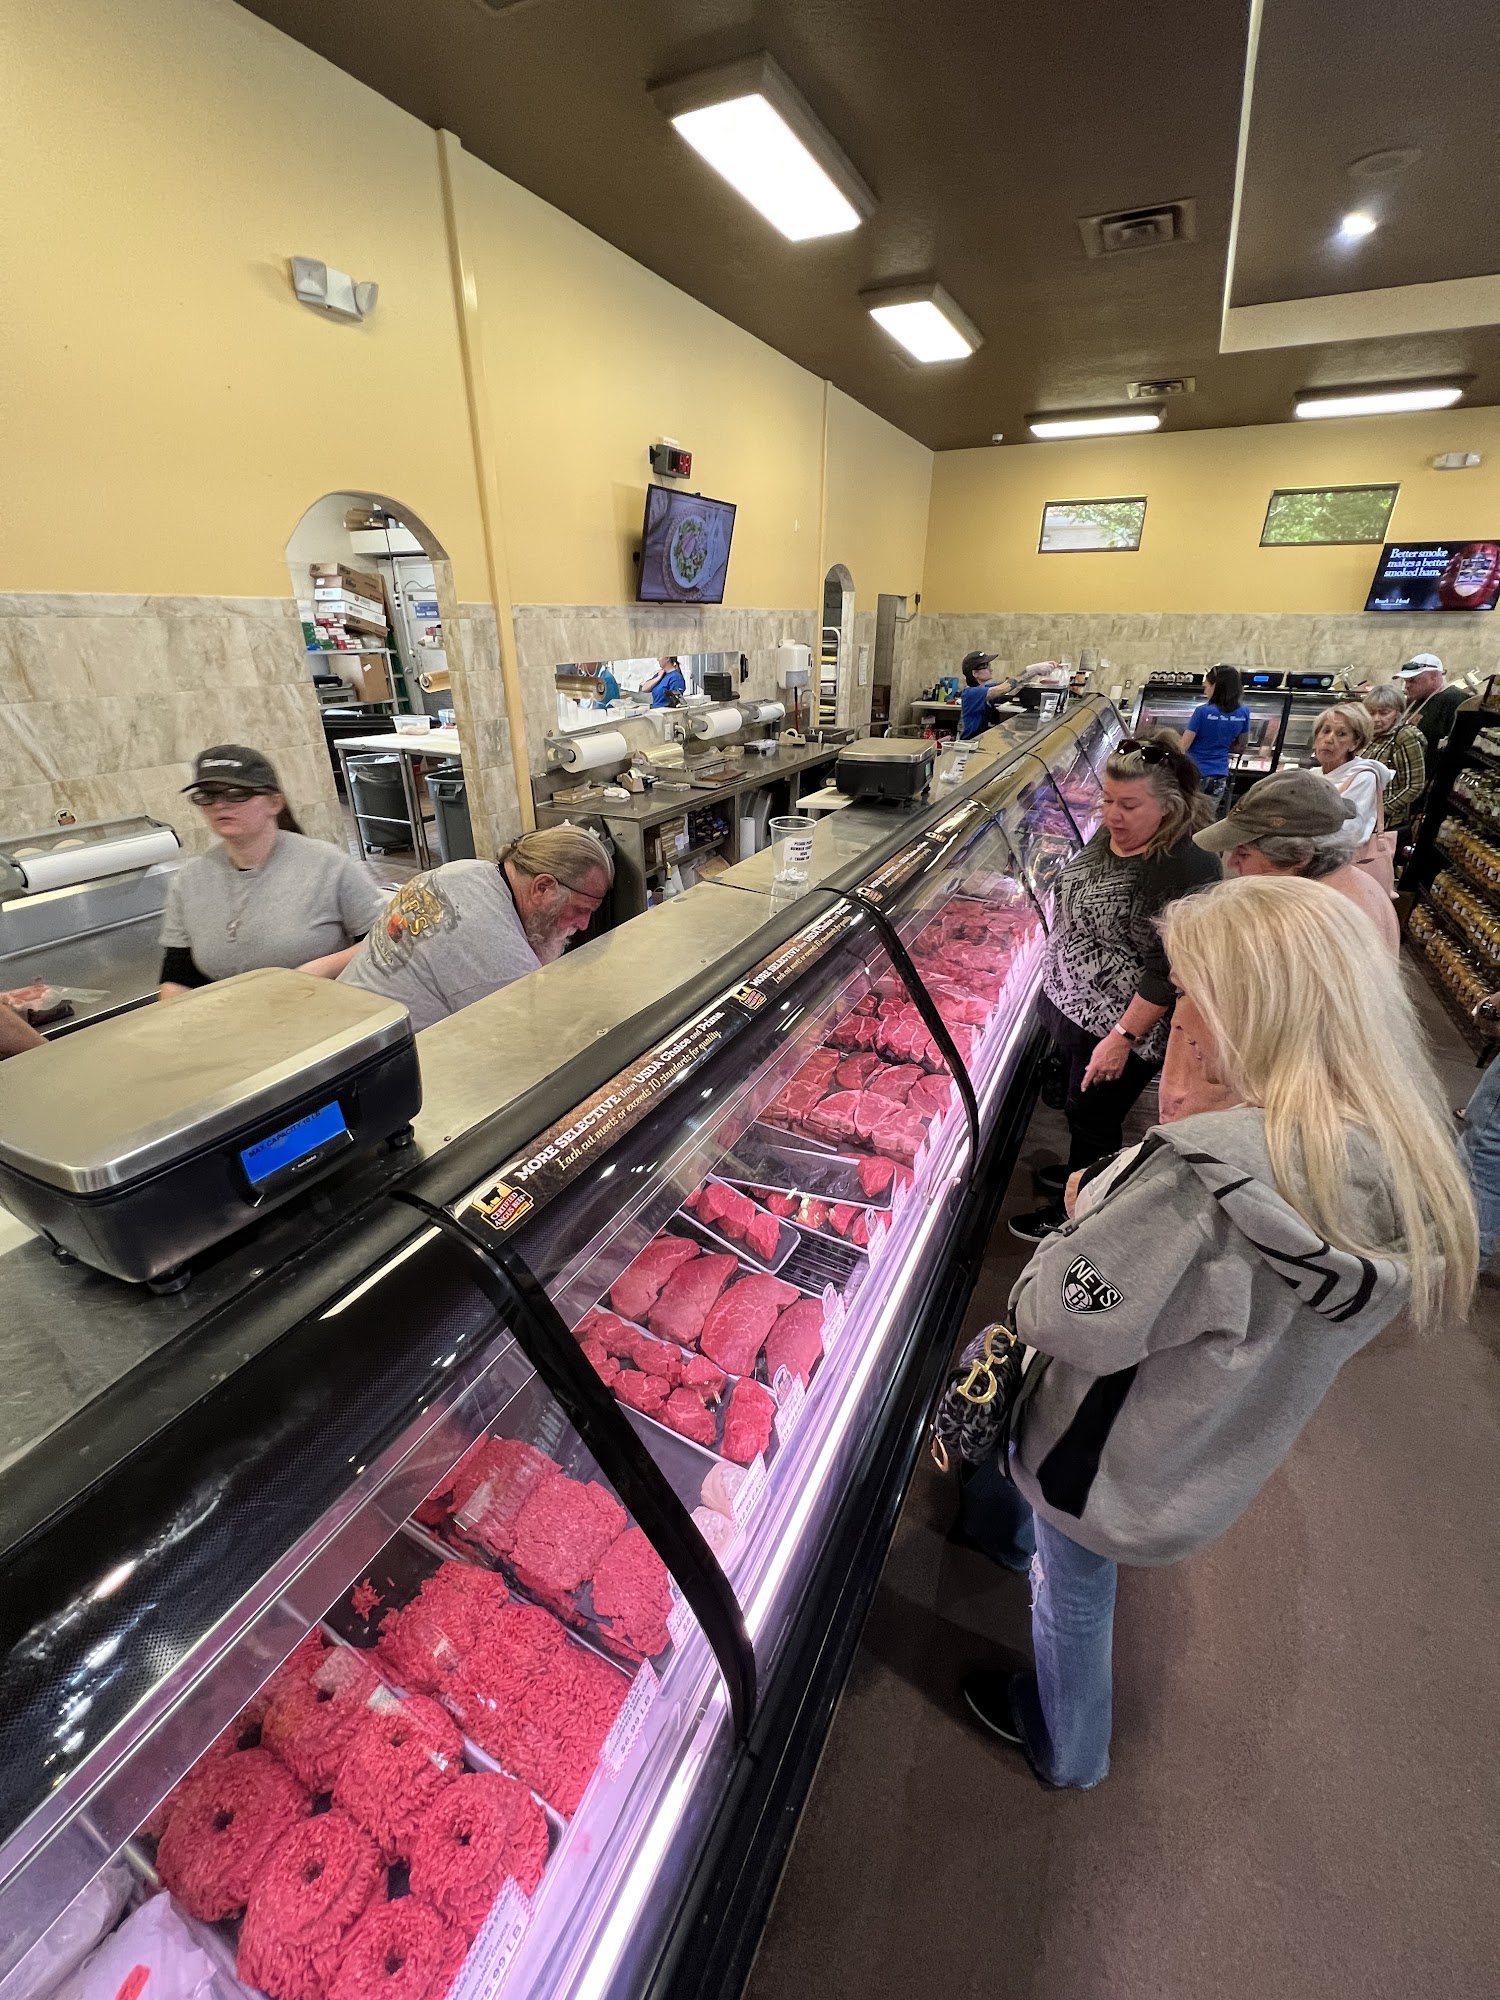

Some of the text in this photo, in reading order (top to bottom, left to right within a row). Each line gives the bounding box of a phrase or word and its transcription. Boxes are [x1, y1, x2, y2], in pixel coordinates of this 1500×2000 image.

[1387, 558, 1415, 567] makes
[1422, 558, 1449, 567] better
[1390, 547, 1448, 558] Better smoke
[1384, 567, 1441, 577] smoked ham.
[749, 969, 772, 987] MORE
[767, 946, 800, 973] SELECTIVE
[513, 1144, 560, 1182] MORE
[554, 1094, 622, 1150] SELECTIVE
[619, 1082, 639, 1098] than
[632, 1060, 666, 1083] USDA
[659, 1037, 692, 1062] Choice
[690, 1028, 703, 1041] and
[555, 1147, 583, 1171] Each
[581, 1135, 597, 1150] cut
[594, 1116, 619, 1139] meets
[617, 1109, 627, 1119] or
[626, 1088, 652, 1112] exceeds
[648, 1078, 661, 1091] 10
[660, 1054, 692, 1083] standards
[688, 1047, 701, 1060] for
[248, 1144, 265, 1159] MAX
[266, 1122, 301, 1147] CAPACITY
[490, 1191, 518, 1221] CERTIFIED
[494, 1206, 515, 1227] ANGUS
[1070, 1260, 1118, 1307] NETS
[609, 1677, 651, 1759] CHOPPED SIRLOIN
[640, 1694, 651, 1715] LB
[468, 1936, 487, 1973] FRESH
[487, 1923, 494, 1936] IN
[493, 1889, 512, 1923] STORE
[506, 1924, 522, 1952] LB
[469, 1921, 510, 2000] ROUND CHUCK
